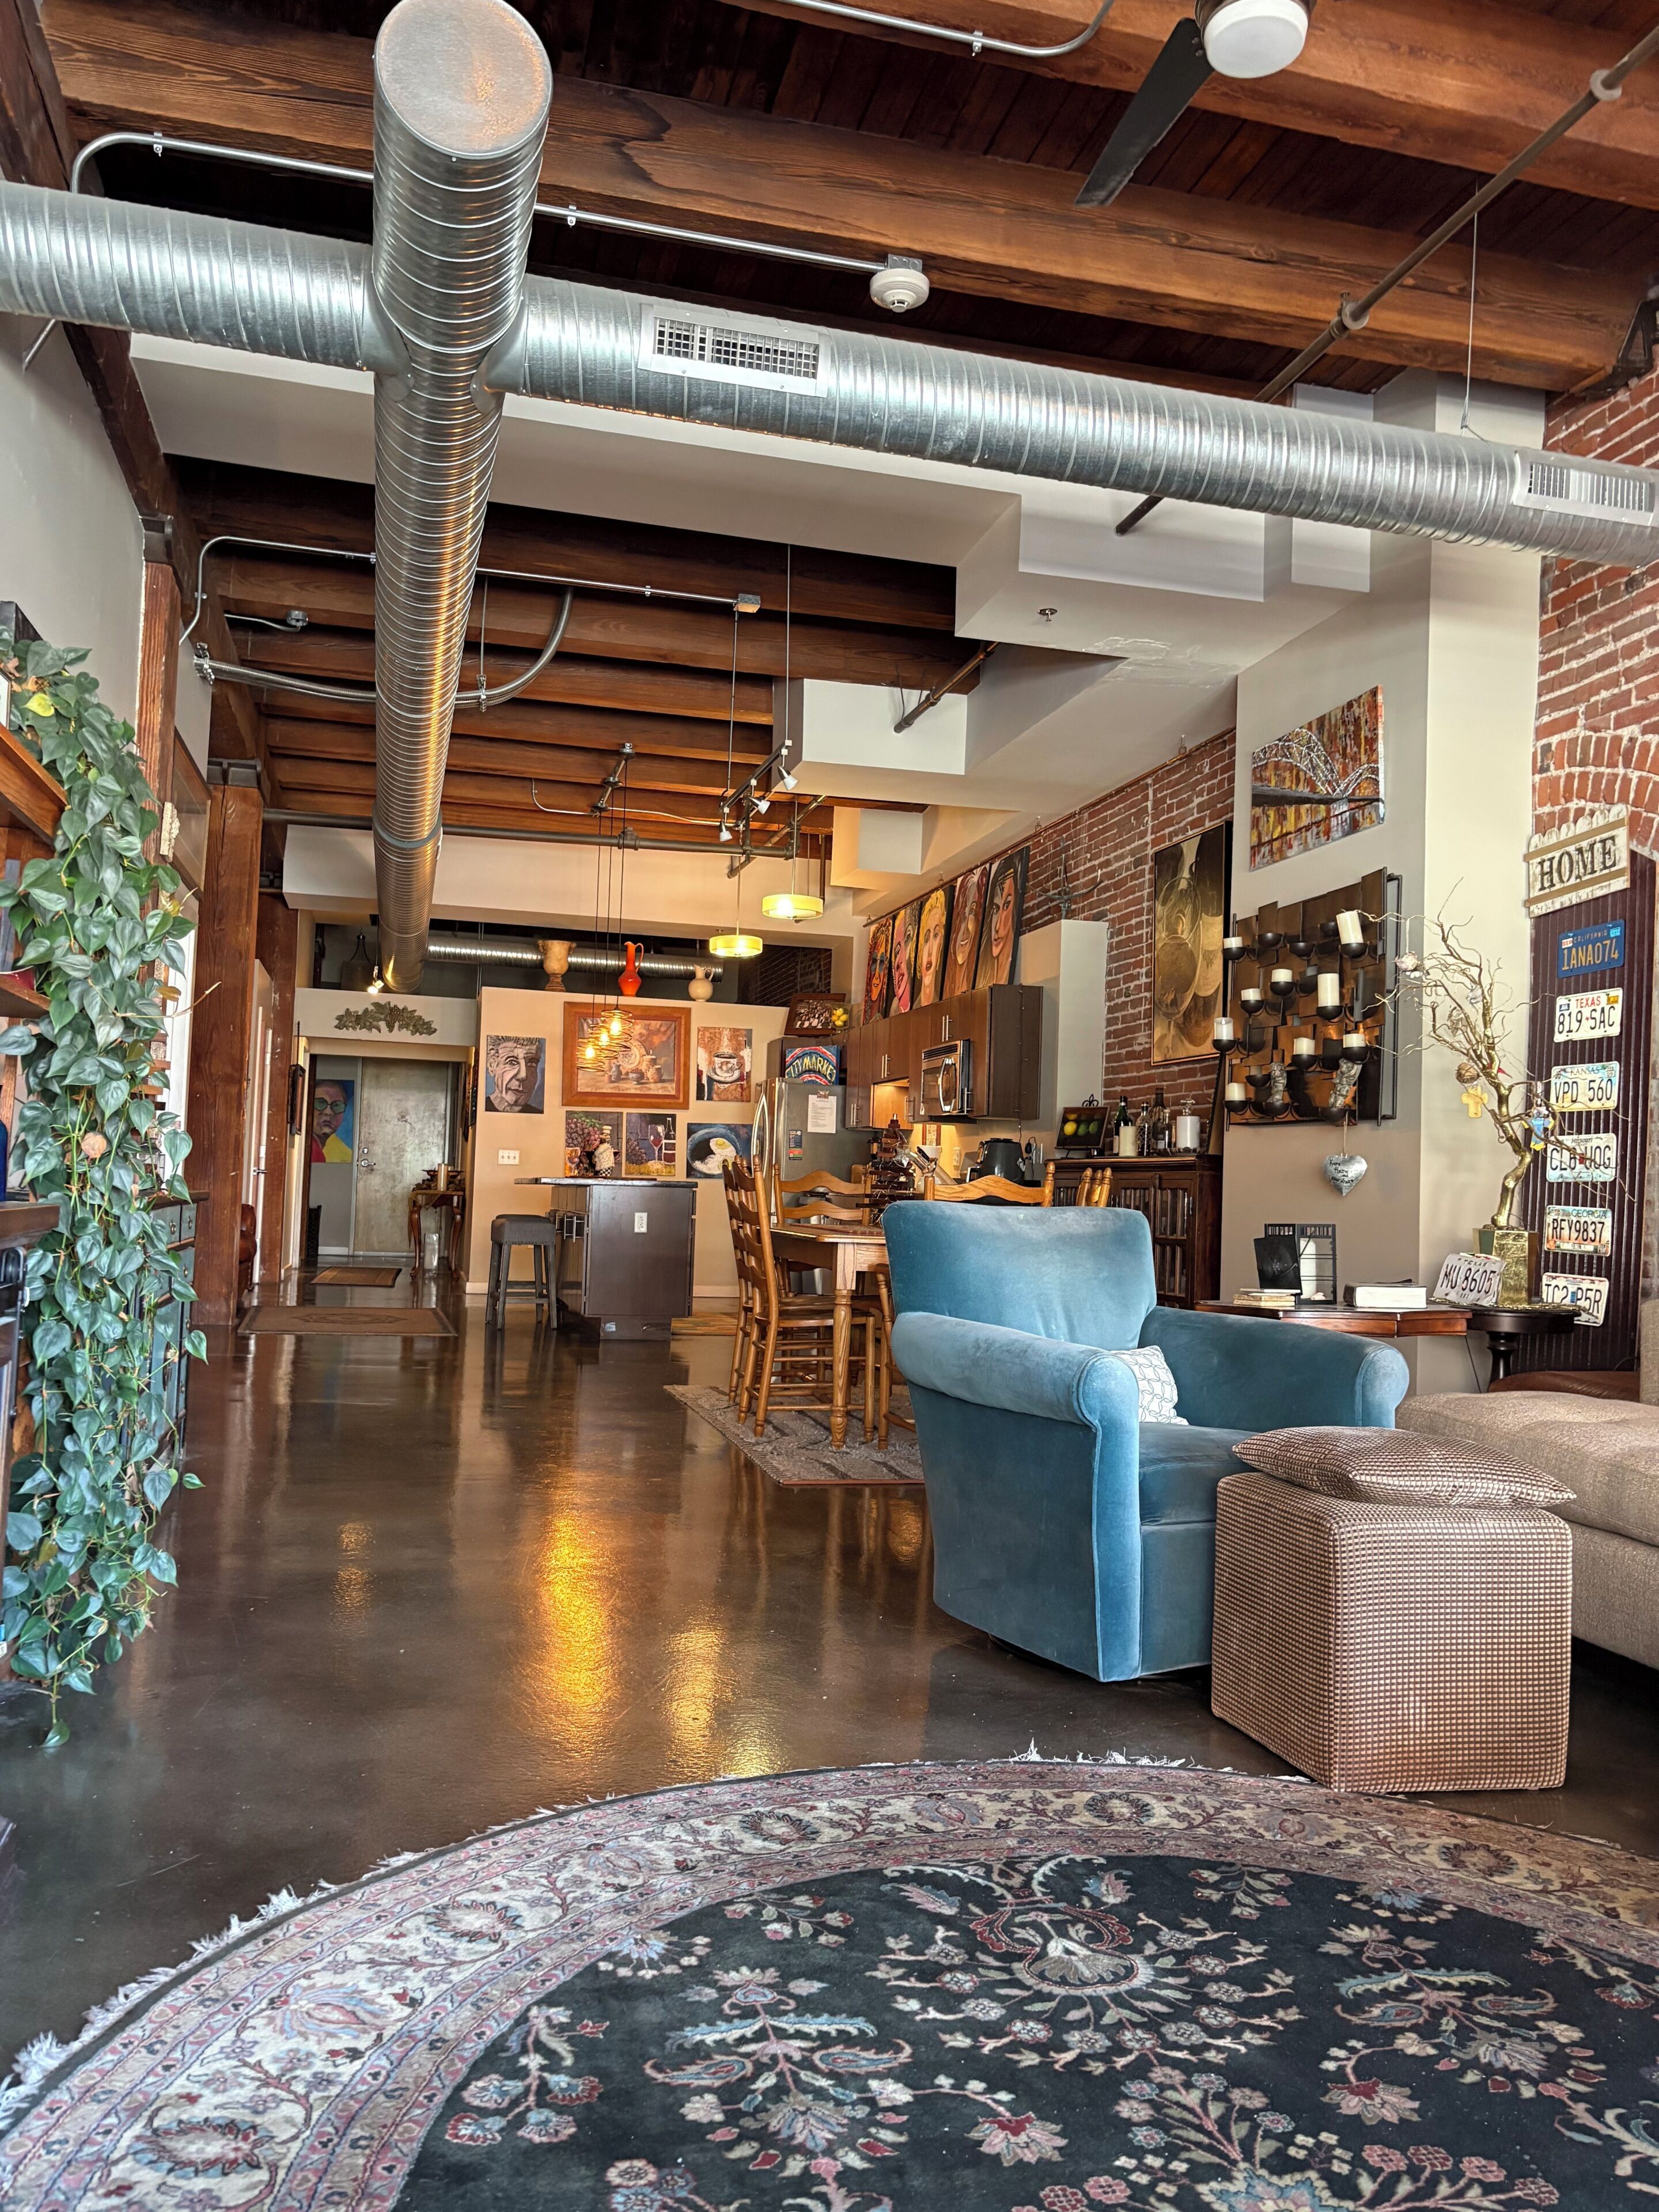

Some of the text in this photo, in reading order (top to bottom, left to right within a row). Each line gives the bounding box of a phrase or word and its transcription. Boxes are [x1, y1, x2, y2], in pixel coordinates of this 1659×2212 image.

[1537, 835, 1616, 892] HOME
[1574, 930, 1608, 943] CALIFORNIA
[1575, 995, 1601, 1009] TEXAS
[1558, 1005, 1615, 1035] 819 SAC
[1570, 1066, 1600, 1075] KANSAS
[1555, 1078, 1613, 1104] VPD 560
[1571, 1209, 1607, 1218] GEORGIA
[1552, 1218, 1605, 1243] RFY9837
[1441, 1264, 1497, 1294] MU 8605
[1575, 1287, 1602, 1314] P5R
